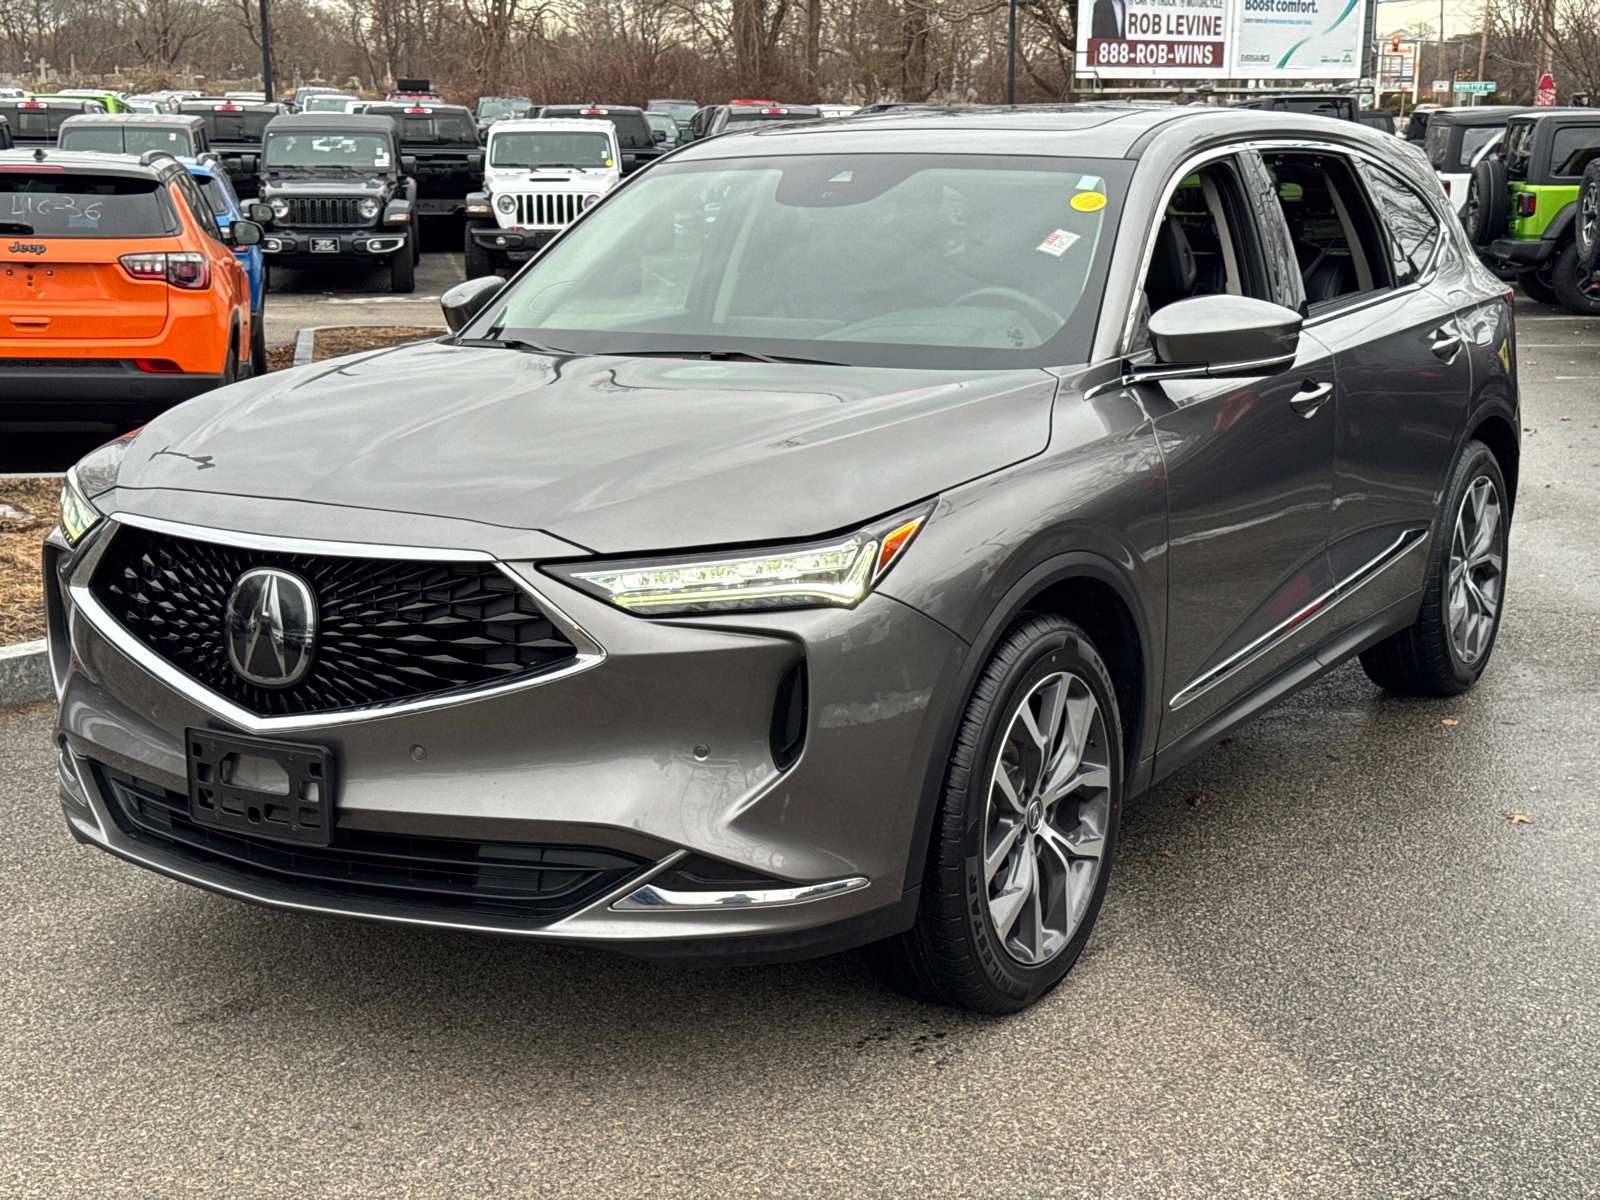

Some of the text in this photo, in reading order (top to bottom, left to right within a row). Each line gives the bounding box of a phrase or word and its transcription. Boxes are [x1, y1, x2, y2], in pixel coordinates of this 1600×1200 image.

[1244, 0, 1319, 13] Boost comfort.
[1128, 13, 1222, 36] ROB LEVINE
[1098, 42, 1214, 65] 888-ROB-WINS
[8, 241, 47, 255] Jeep
[967, 873, 1013, 994] MILESTAR
